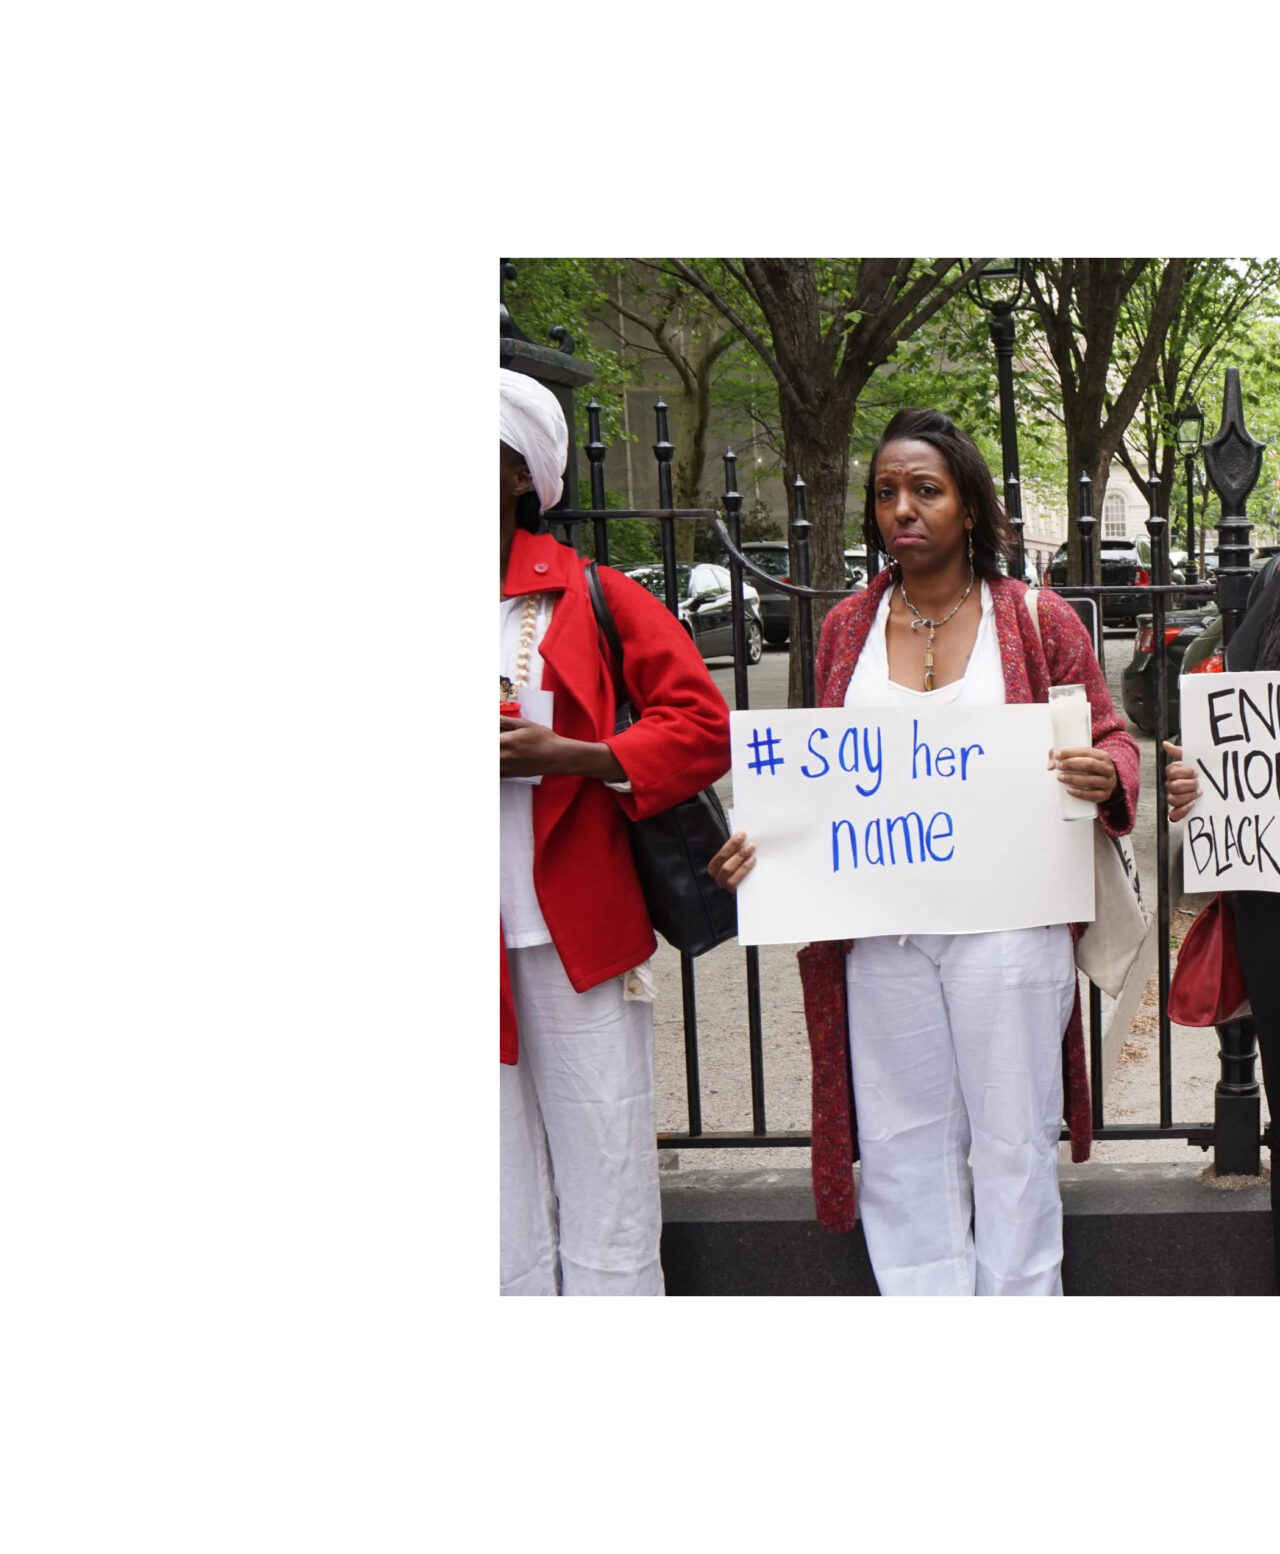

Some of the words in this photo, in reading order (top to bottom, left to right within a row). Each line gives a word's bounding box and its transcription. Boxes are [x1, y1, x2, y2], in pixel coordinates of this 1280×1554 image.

[747, 727, 785, 776] #
[800, 726, 883, 797] say
[912, 719, 985, 781] her
[832, 811, 955, 873] name
